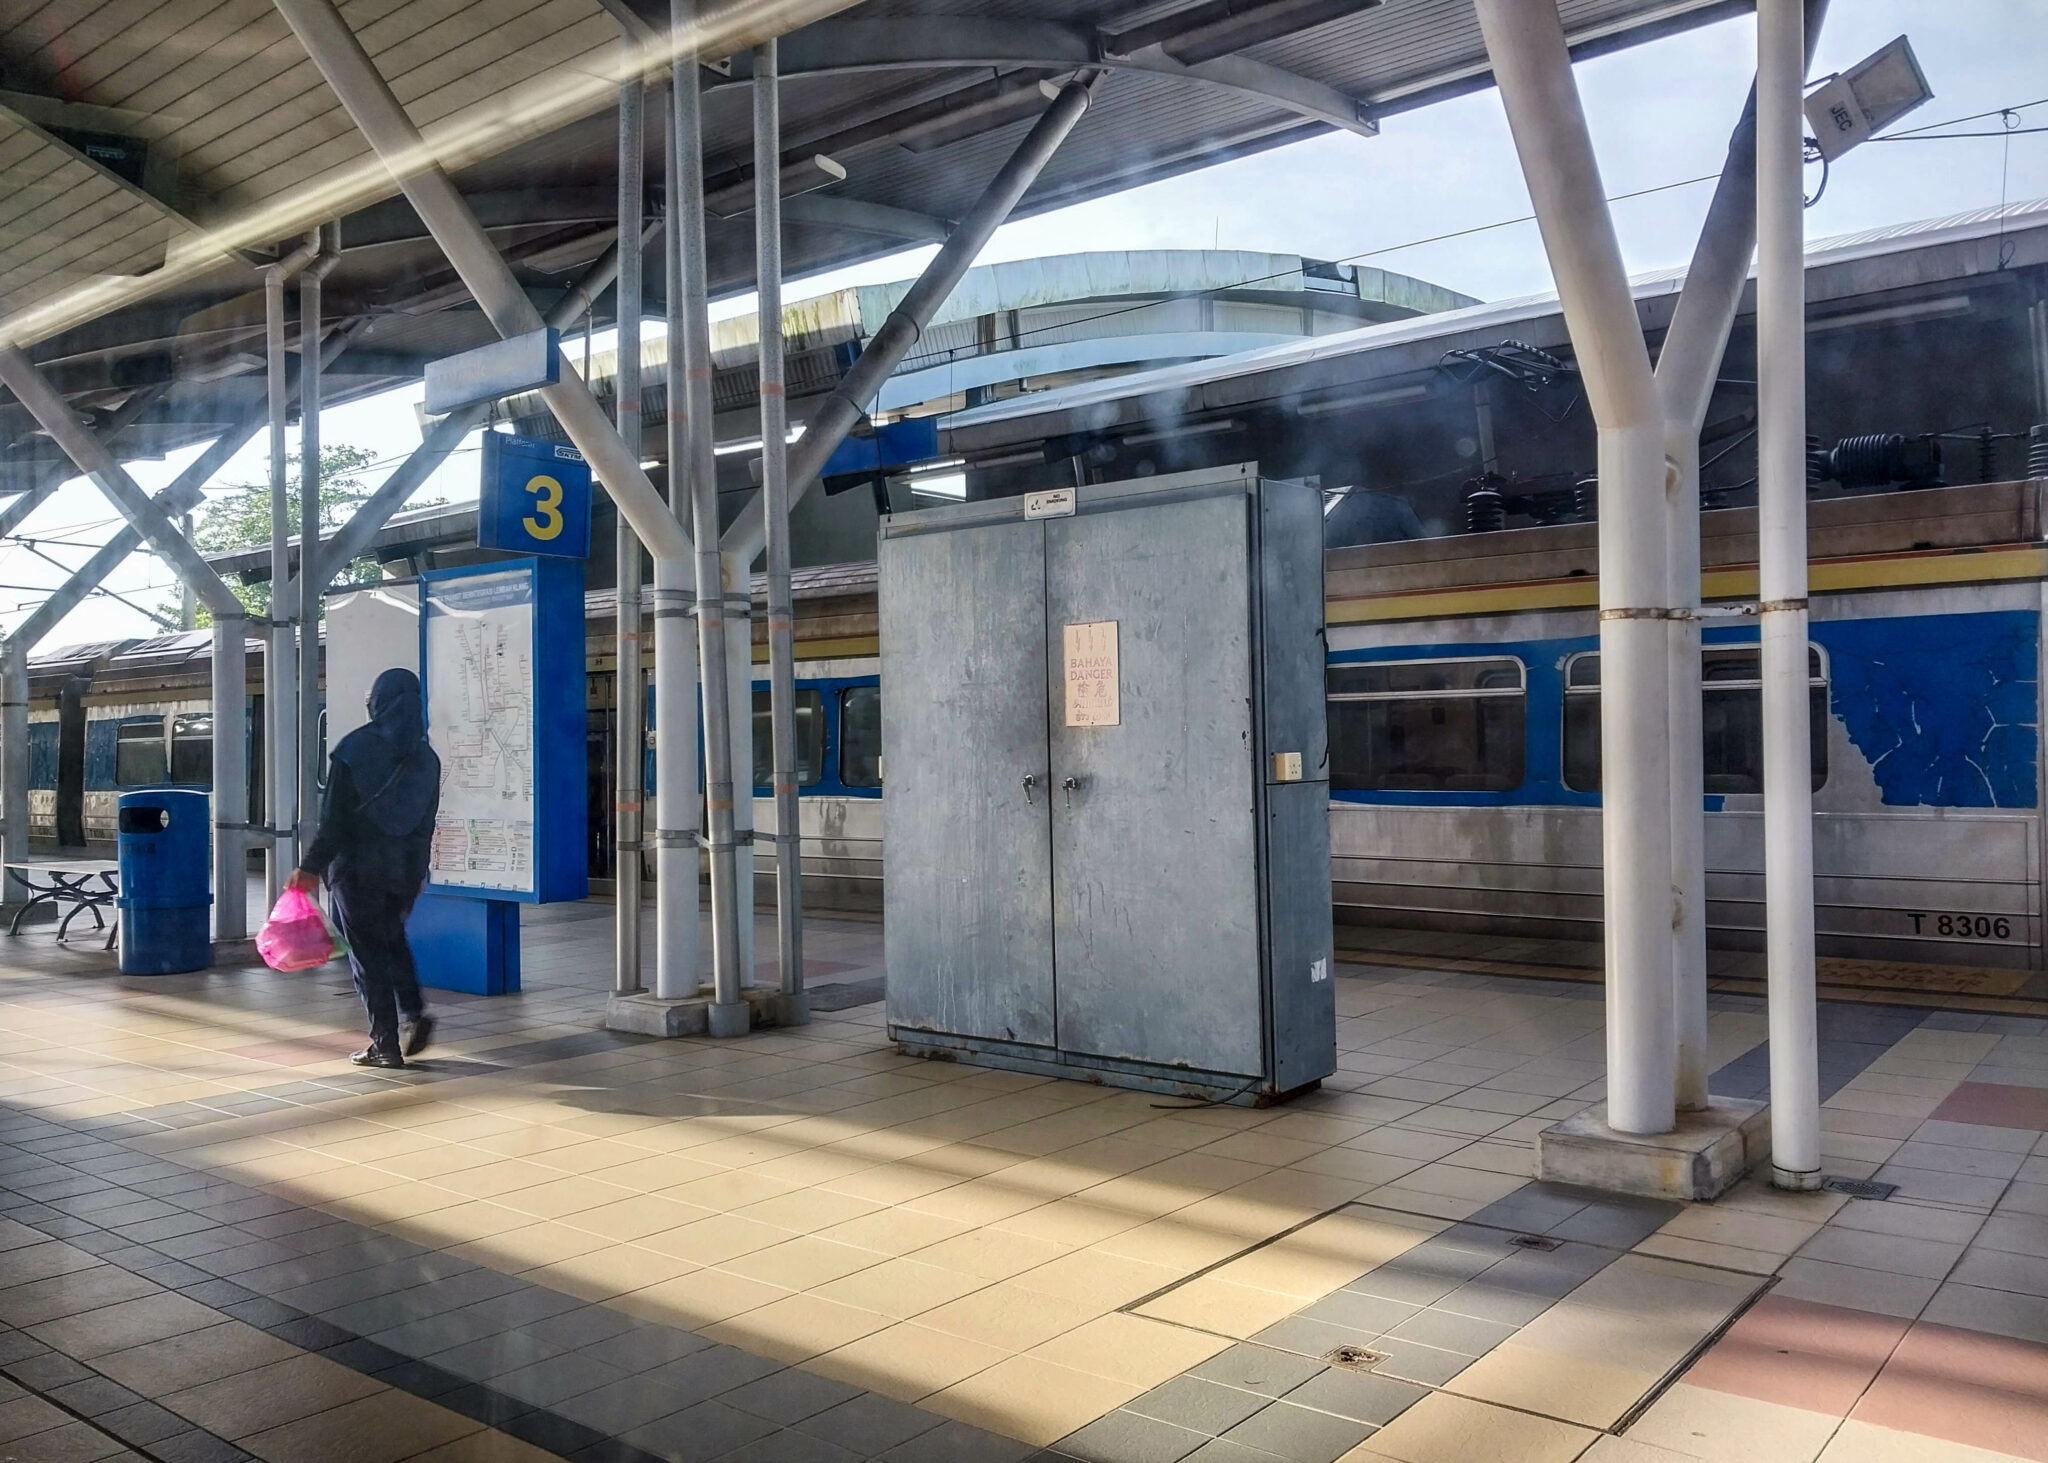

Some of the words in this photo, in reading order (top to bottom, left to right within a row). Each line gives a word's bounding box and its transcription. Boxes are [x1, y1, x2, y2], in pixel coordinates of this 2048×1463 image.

[1831, 107, 1852, 131] JEC
[522, 475, 564, 541] 3
[1070, 656, 1112, 669] BAHAYA
[1070, 668, 1112, 681] DANGER
[1907, 914, 1926, 934] T
[1937, 915, 2011, 939] 8306
